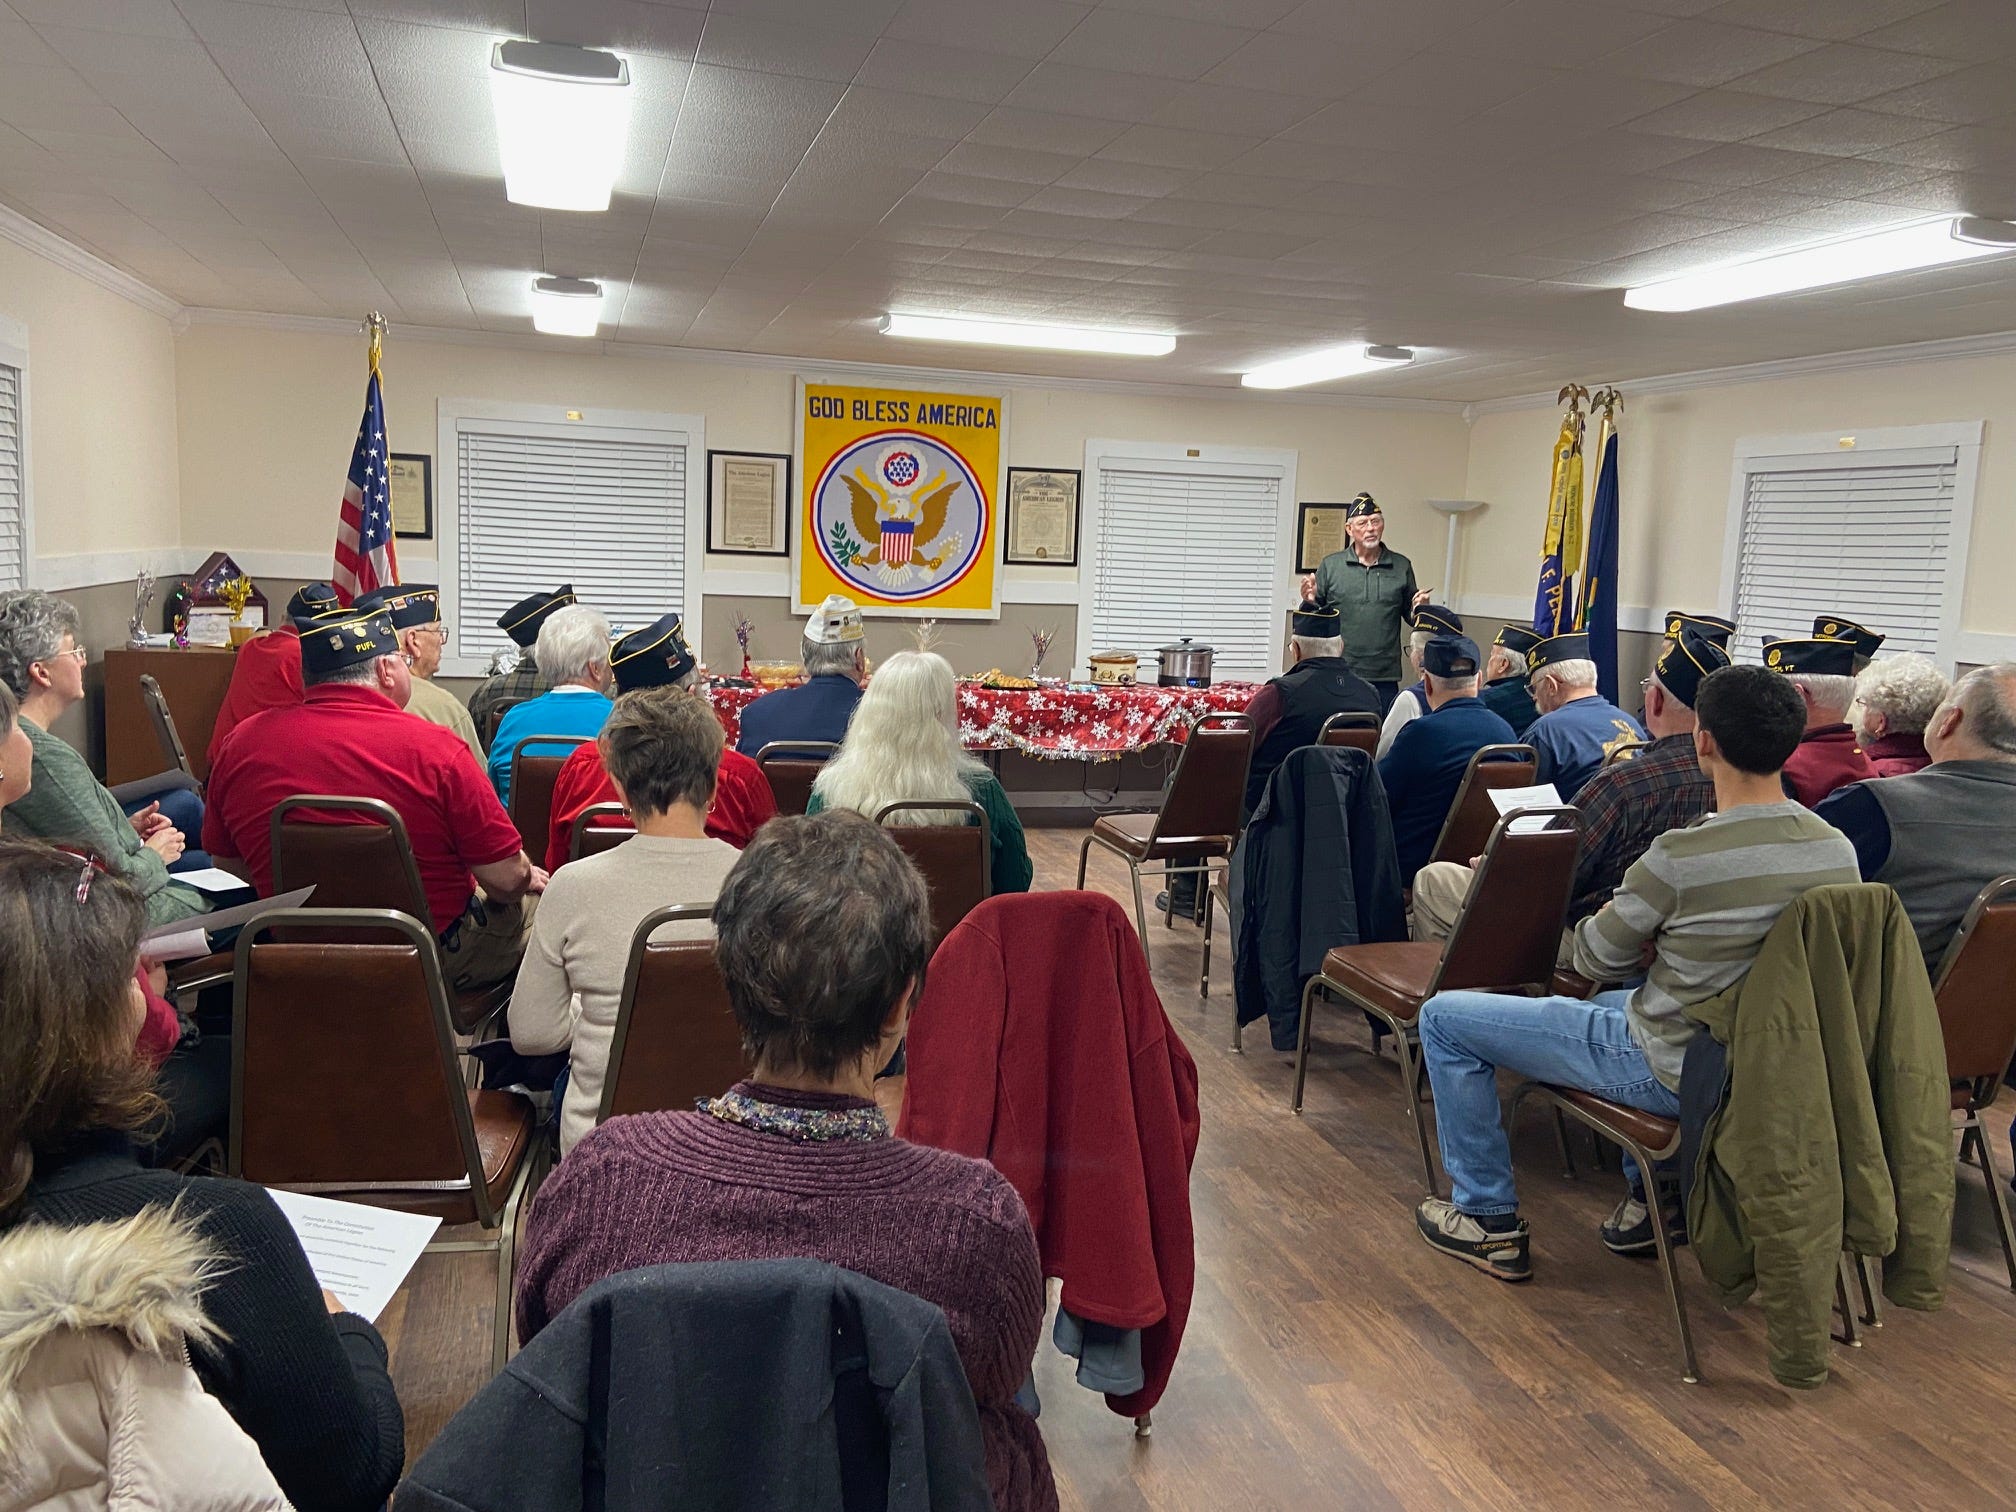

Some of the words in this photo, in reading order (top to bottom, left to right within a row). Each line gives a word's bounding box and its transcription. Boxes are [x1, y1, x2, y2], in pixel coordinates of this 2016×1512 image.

[809, 396, 845, 419] GOD
[852, 399, 910, 423] BLESS
[916, 403, 997, 429] AMERICA
[355, 641, 376, 653] PUFL
